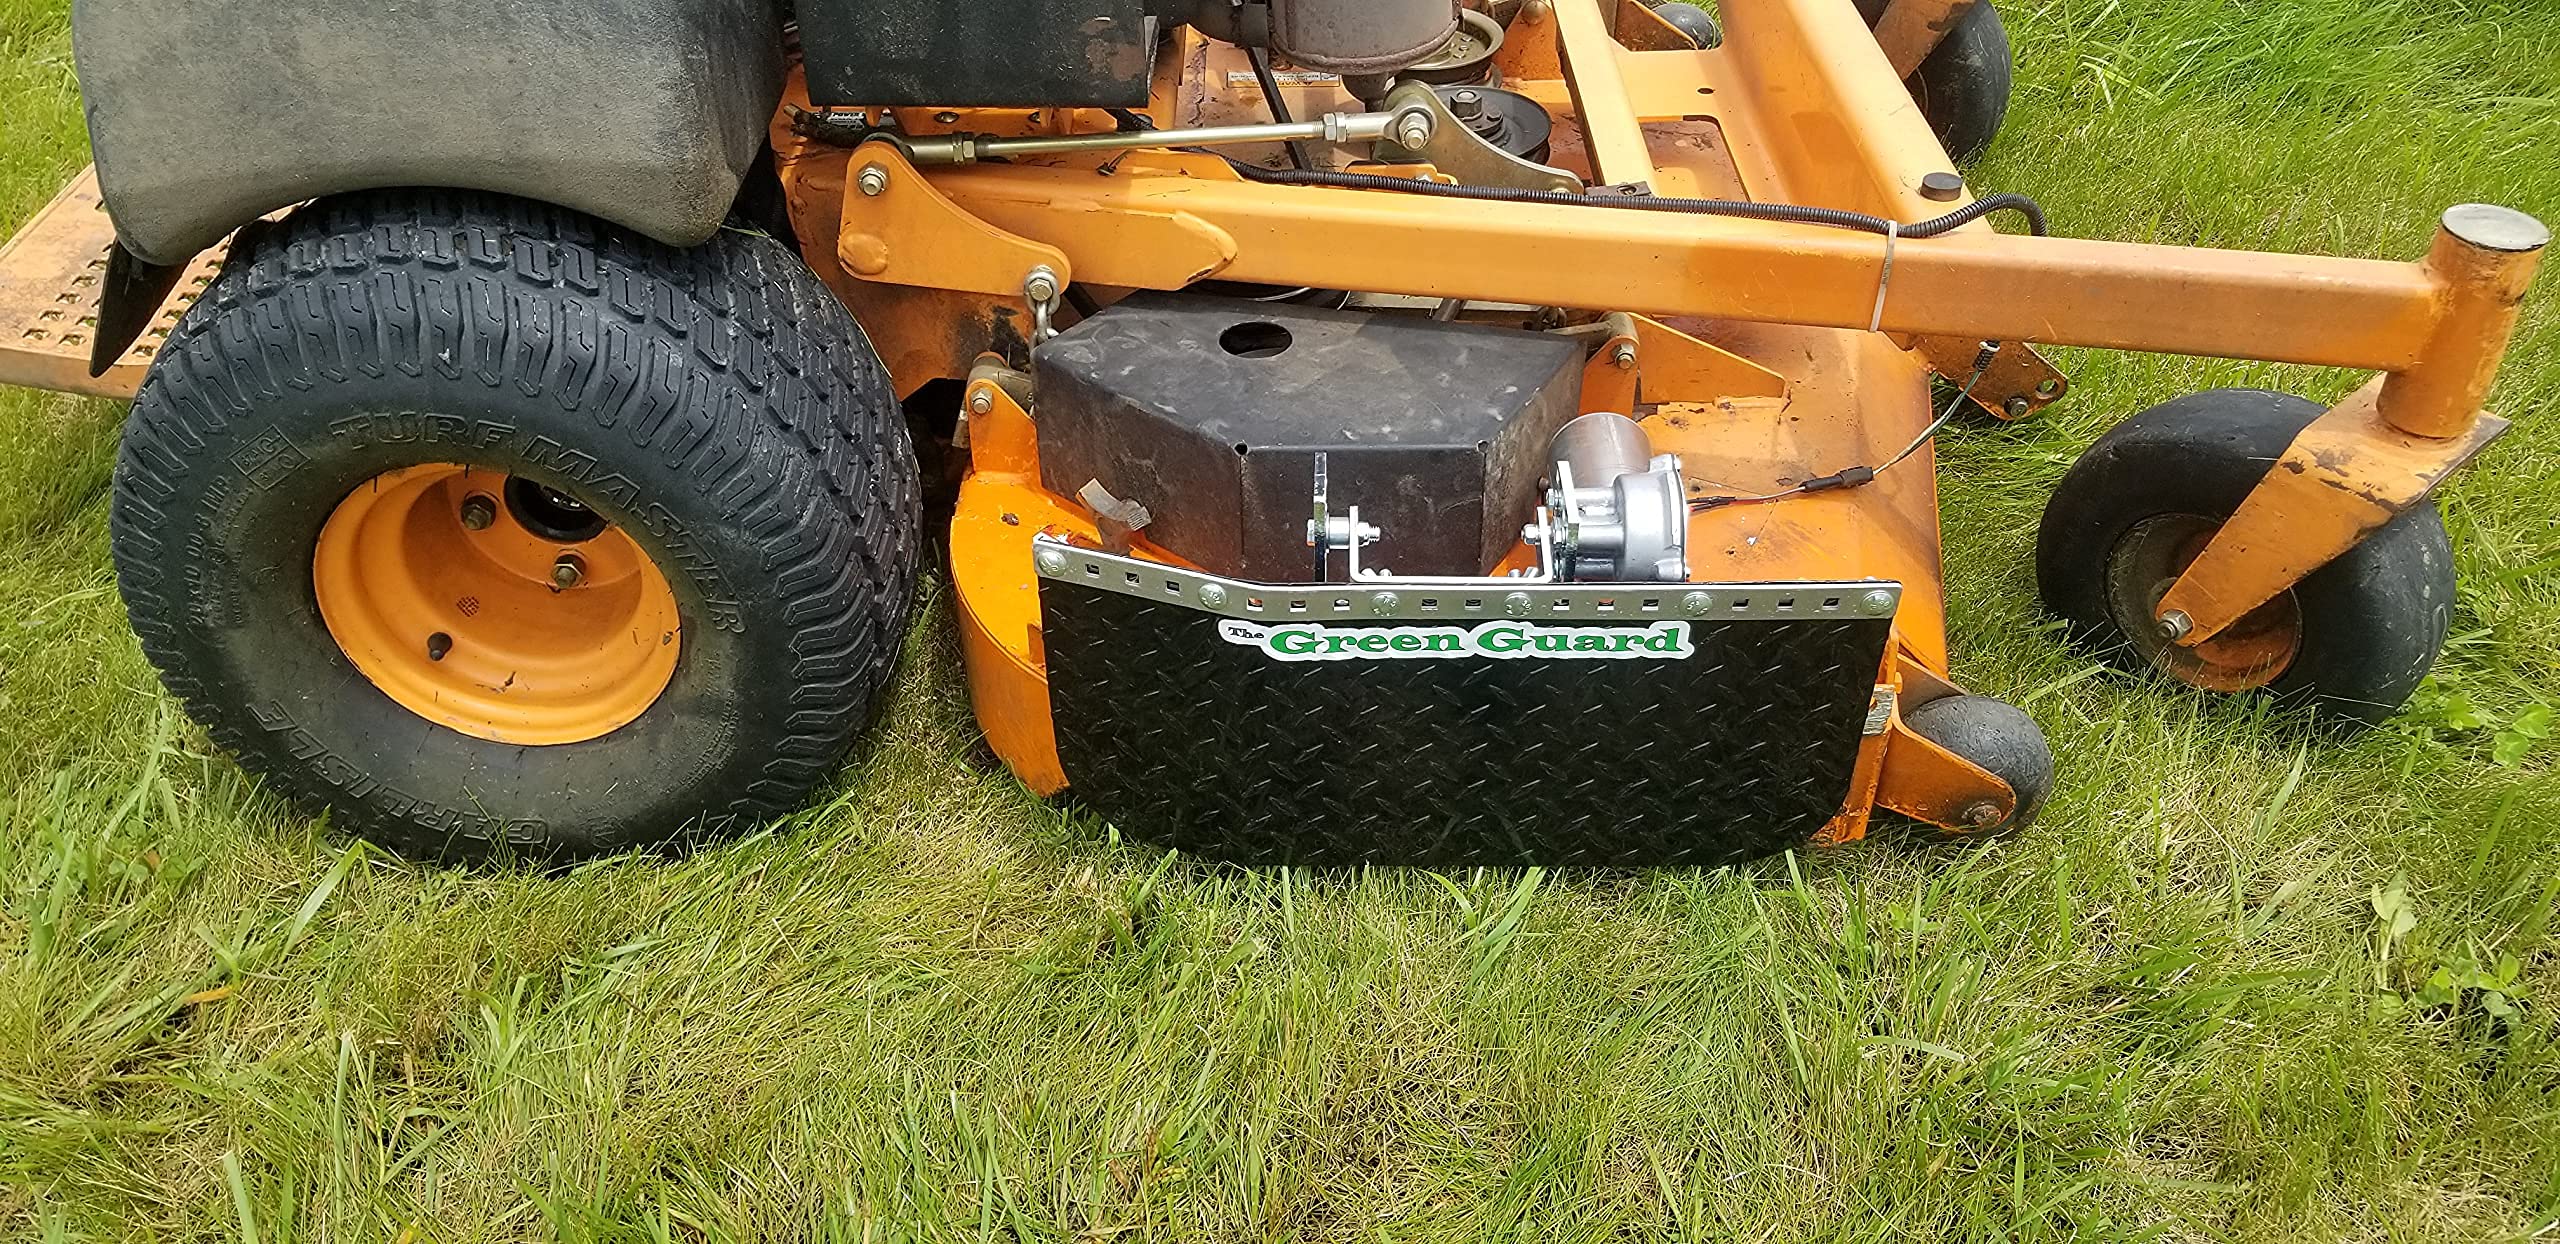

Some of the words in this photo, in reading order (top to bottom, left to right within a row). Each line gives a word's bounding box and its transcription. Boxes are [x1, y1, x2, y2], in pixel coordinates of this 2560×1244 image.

[329, 411, 516, 449] TURF
[521, 435, 746, 634] MASTER
[1228, 626, 1264, 640] The
[1270, 630, 1463, 654] Green
[1477, 627, 1685, 652] Guard
[245, 699, 549, 844] CARLISLE
